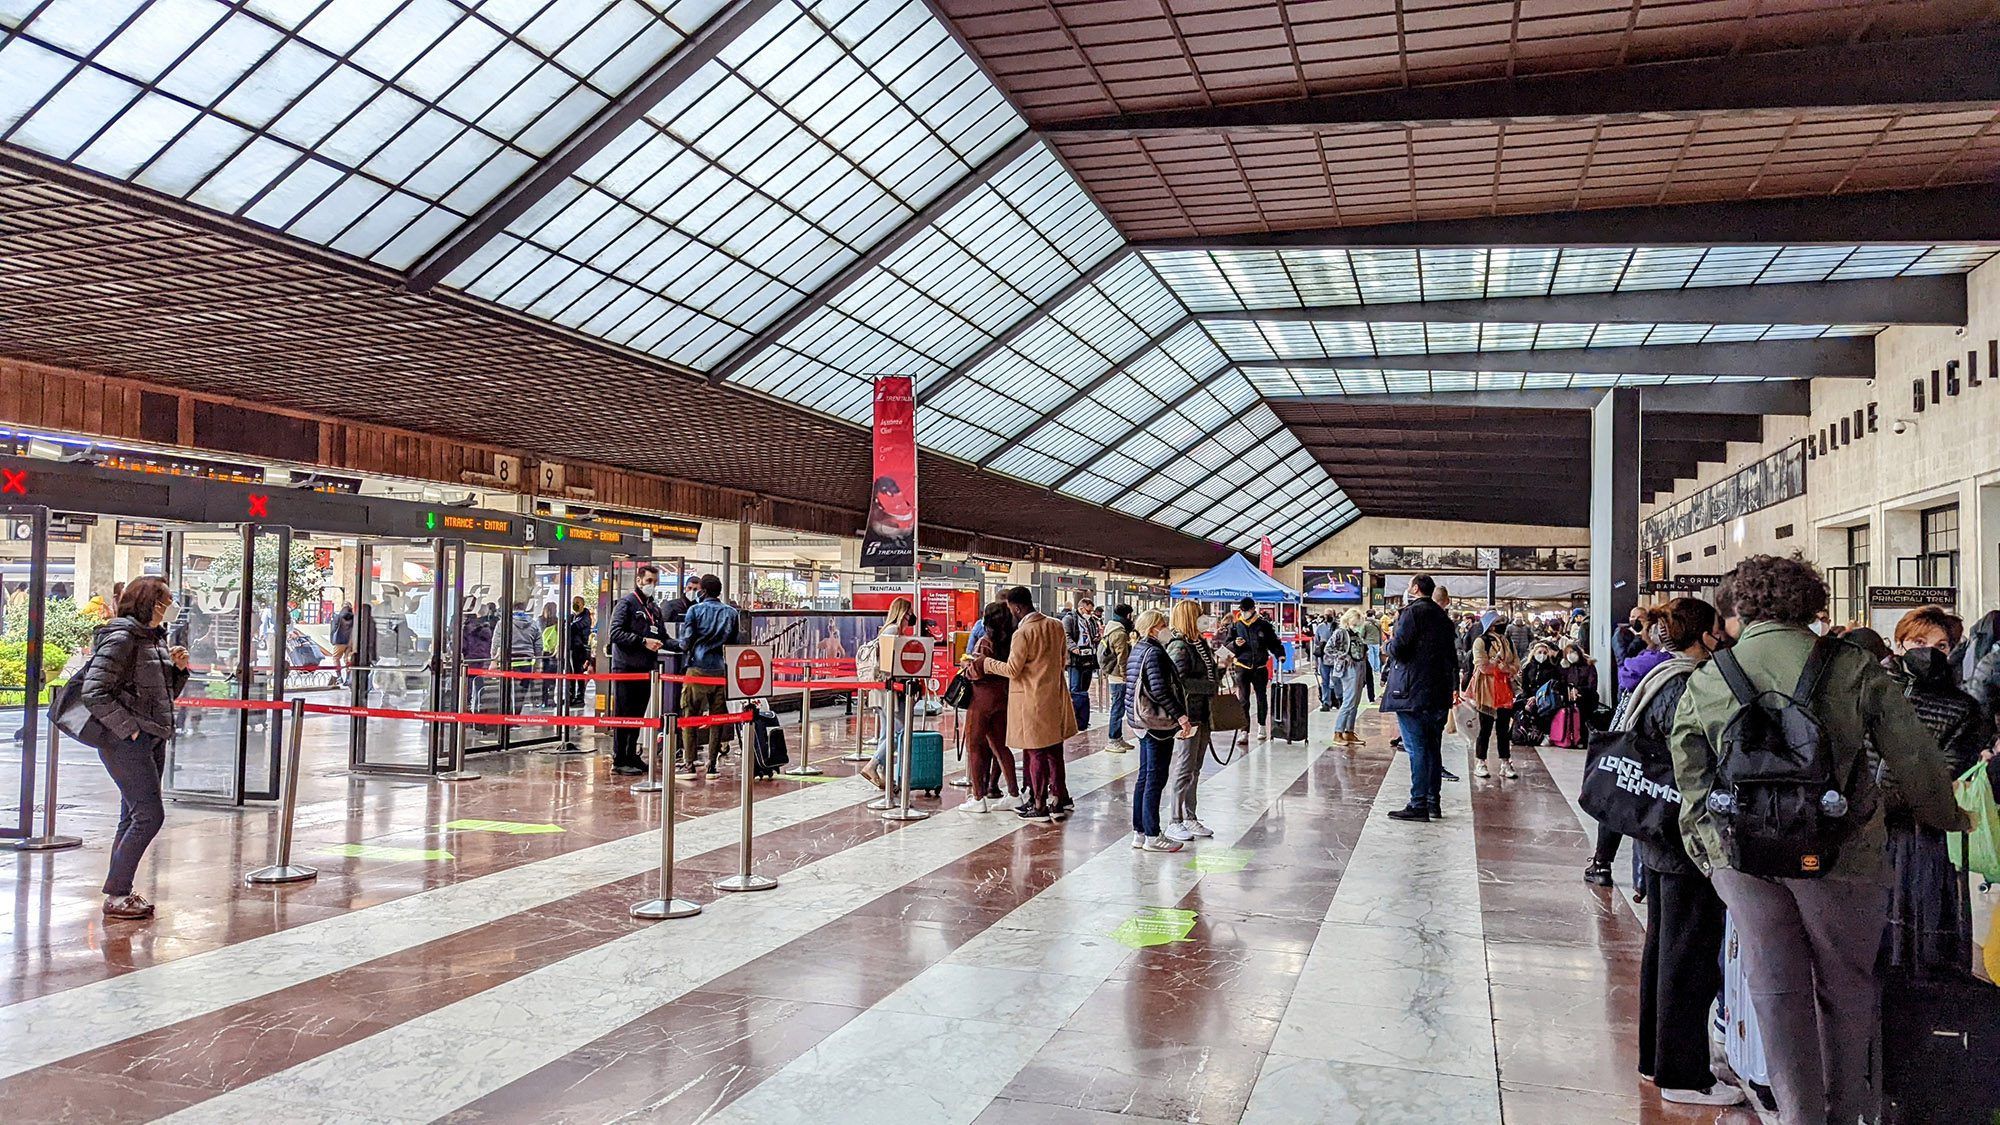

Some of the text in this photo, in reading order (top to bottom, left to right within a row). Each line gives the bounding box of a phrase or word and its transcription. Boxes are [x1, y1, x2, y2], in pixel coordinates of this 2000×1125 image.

[500, 460, 509, 481] 8
[545, 468, 553, 488] 9
[525, 524, 535, 542] B
[1220, 589, 1253, 598] Ferroviaria
[1616, 774, 1682, 804] CHAMP
